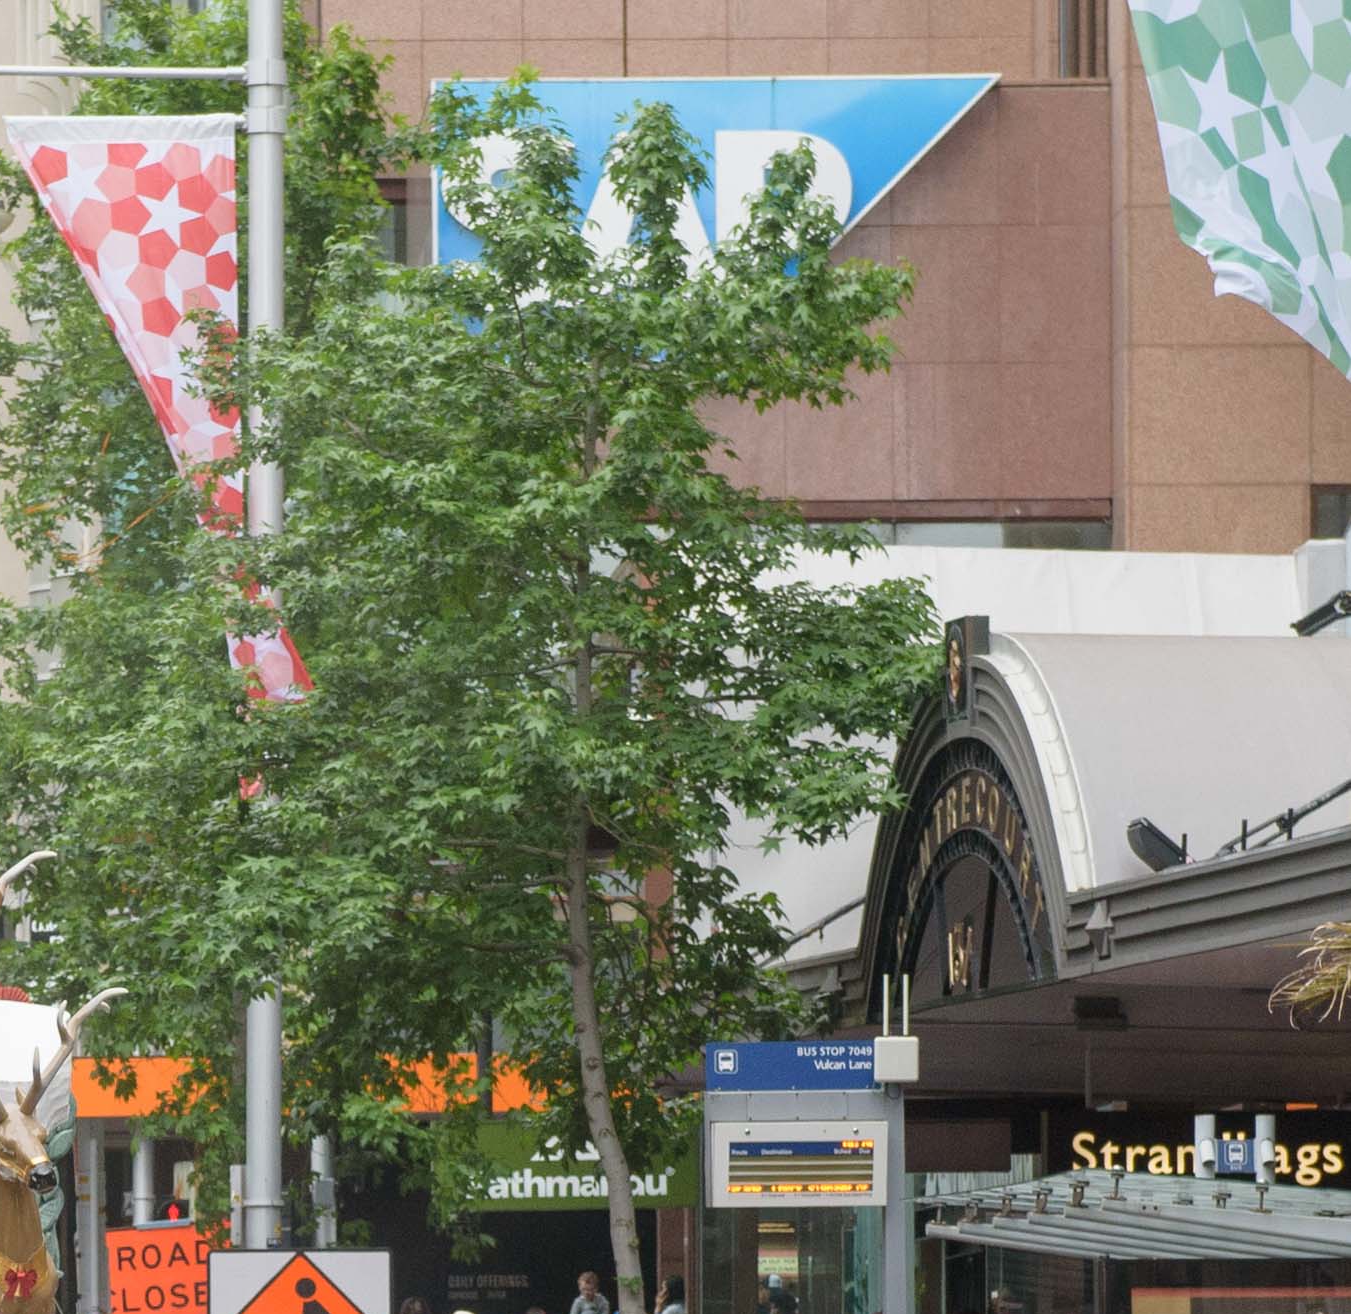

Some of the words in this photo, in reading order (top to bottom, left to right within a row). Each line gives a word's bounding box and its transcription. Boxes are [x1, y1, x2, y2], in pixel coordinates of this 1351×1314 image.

[797, 1047, 817, 1057] BUS
[820, 1046, 845, 1057] STOP
[848, 1046, 872, 1056] 7049
[814, 1060, 846, 1070] Vulcan
[849, 1059, 872, 1070] Lane
[1072, 1131, 1343, 1187] Stranags
[466, 1168, 667, 1199] athmau
[116, 1240, 209, 1271] ROAD
[110, 1282, 209, 1313] LOSE
